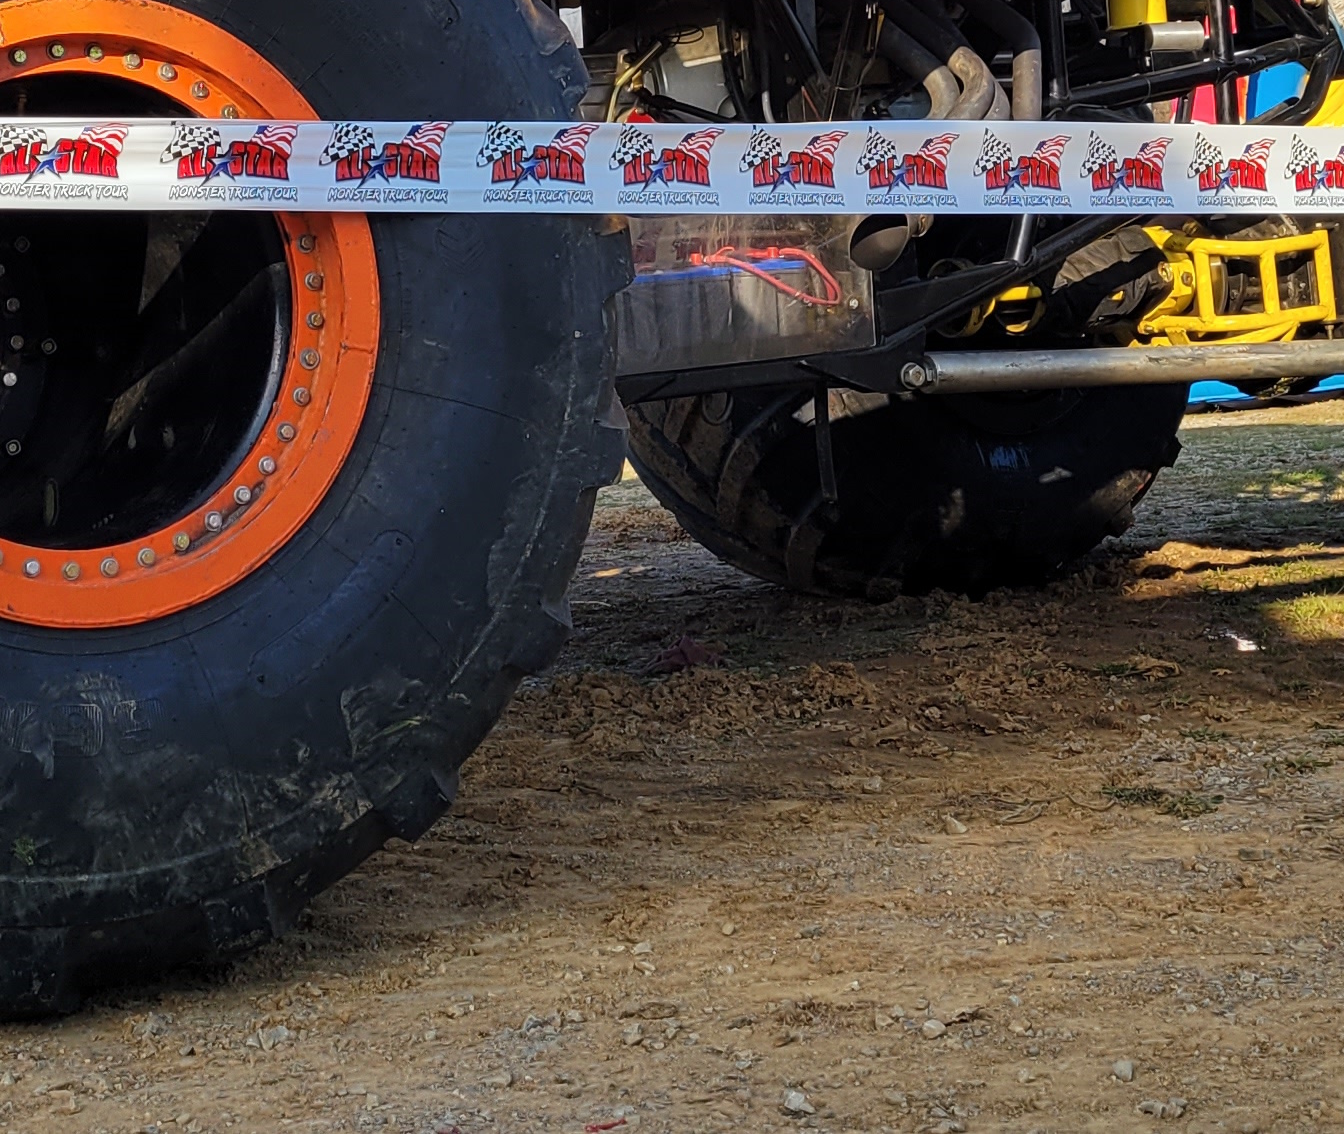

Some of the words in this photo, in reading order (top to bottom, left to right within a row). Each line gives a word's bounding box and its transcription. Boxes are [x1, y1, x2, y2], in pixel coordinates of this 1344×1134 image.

[56, 138, 119, 178] STAR
[229, 141, 290, 182] STAR
[383, 143, 440, 184] STAR
[536, 145, 586, 185] STAR
[661, 148, 710, 188] STAR
[53, 183, 94, 198] TRUCK
[96, 184, 128, 199] TOUR
[169, 185, 226, 200] MONSTER
[227, 186, 265, 200] TRUCK
[267, 186, 298, 201] TOUR
[328, 186, 381, 202] MONSTER
[383, 186, 418, 202] TRUCK
[420, 187, 448, 202] TOUR
[484, 188, 532, 203] MONSTER
[534, 188, 566, 204] TRUCK
[567, 189, 593, 204] TOUR
[618, 190, 662, 205] MONSTER
[664, 191, 694, 206] TRUCK
[695, 192, 719, 206] TOUR
